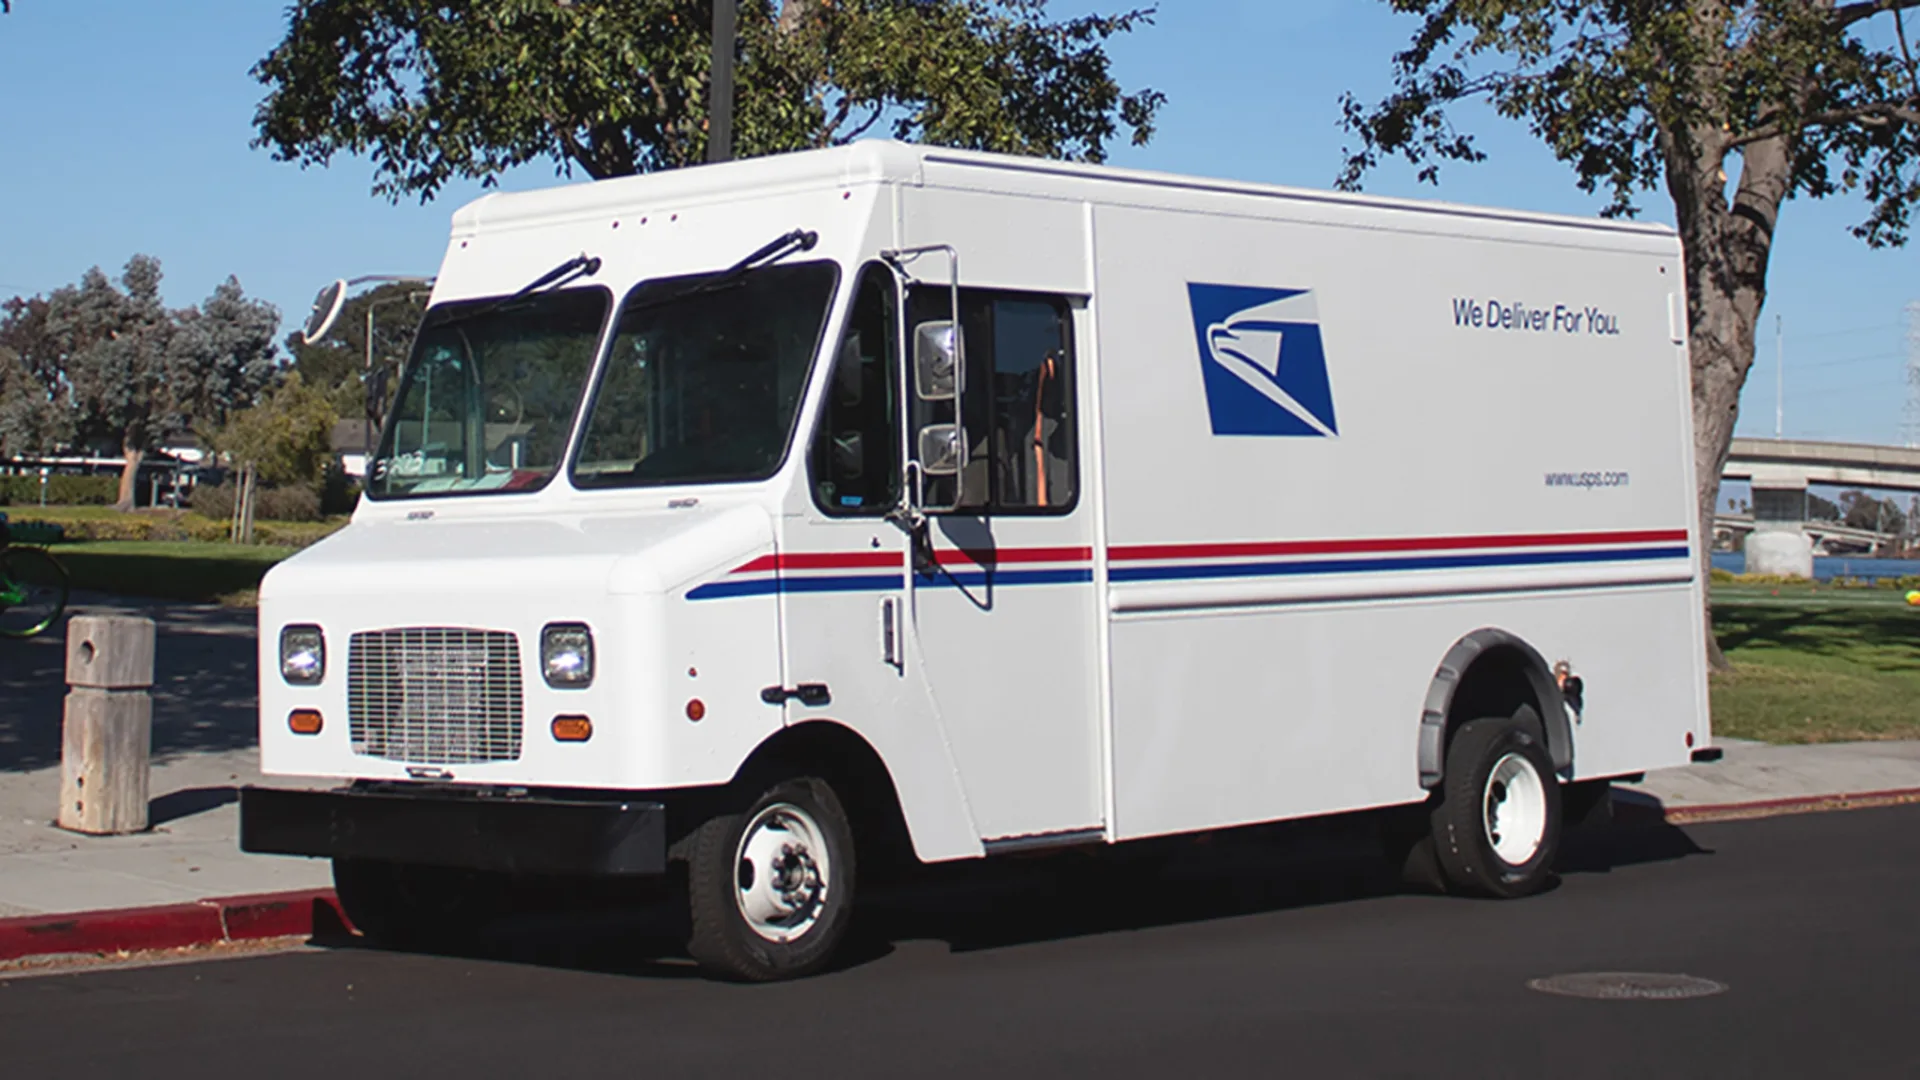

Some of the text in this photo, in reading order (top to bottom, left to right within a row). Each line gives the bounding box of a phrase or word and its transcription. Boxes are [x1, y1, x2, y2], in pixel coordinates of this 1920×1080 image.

[1453, 298, 1620, 335] We Deliver For You.
[1544, 471, 1629, 490] www.usps.com
